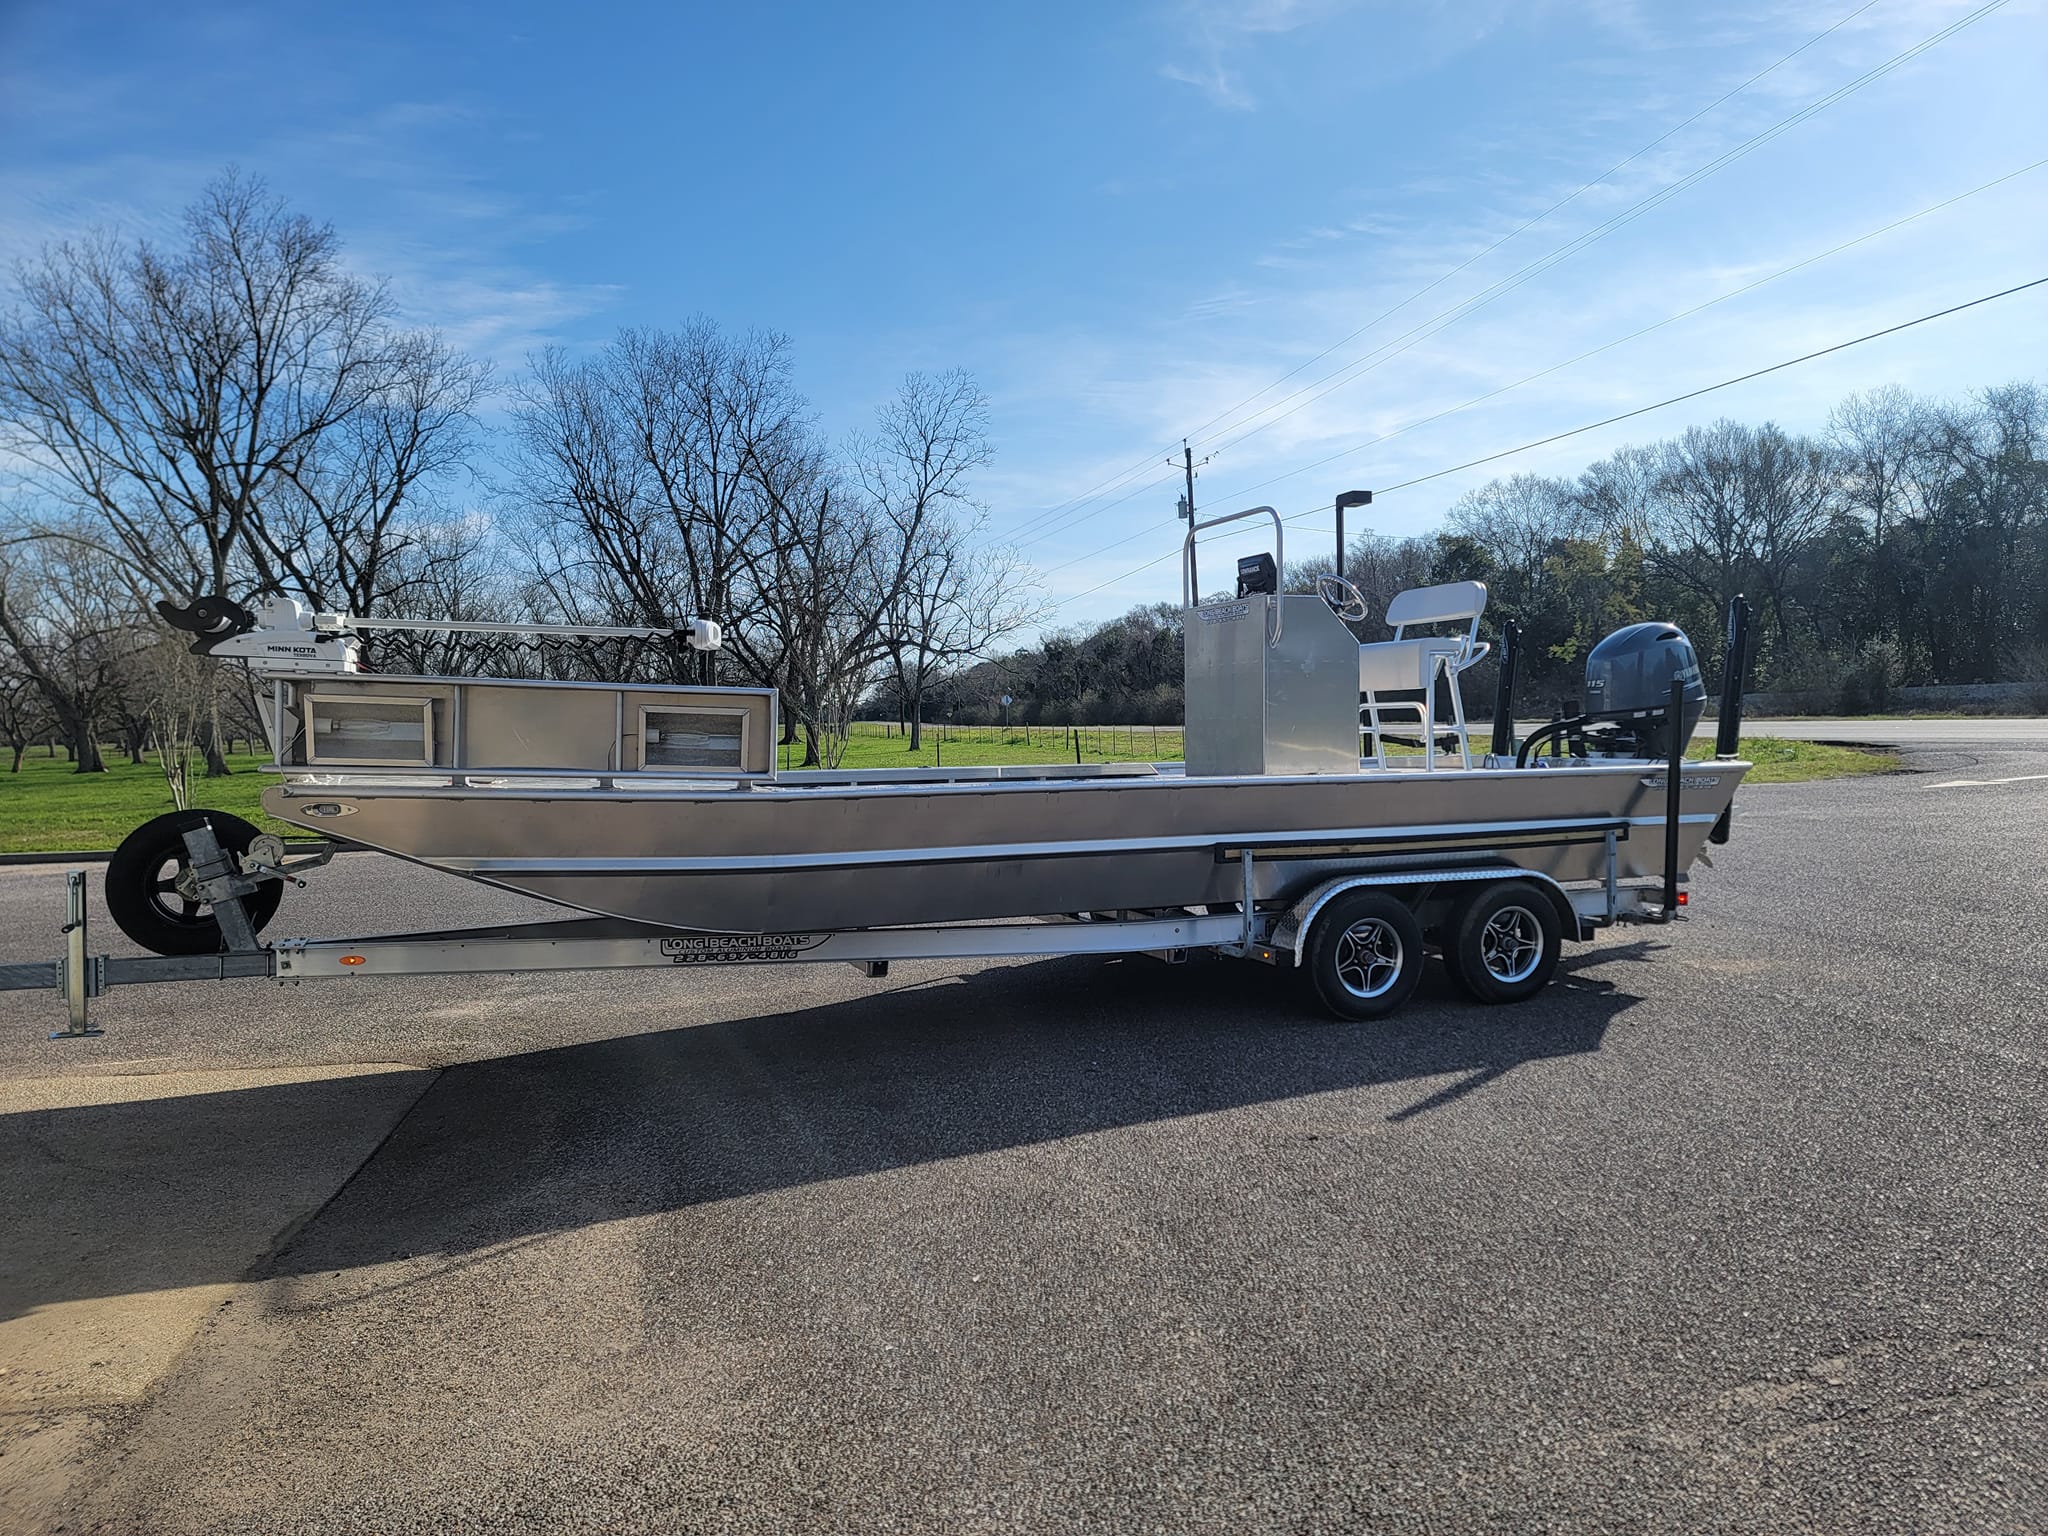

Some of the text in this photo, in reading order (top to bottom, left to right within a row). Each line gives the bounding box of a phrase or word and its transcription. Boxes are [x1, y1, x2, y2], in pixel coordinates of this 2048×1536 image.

[267, 645, 317, 654] MINN KOTA
[1587, 680, 1605, 688] 115
[664, 935, 811, 950] LONG BEACH BOATS
[673, 951, 798, 963] 228-697-4816
